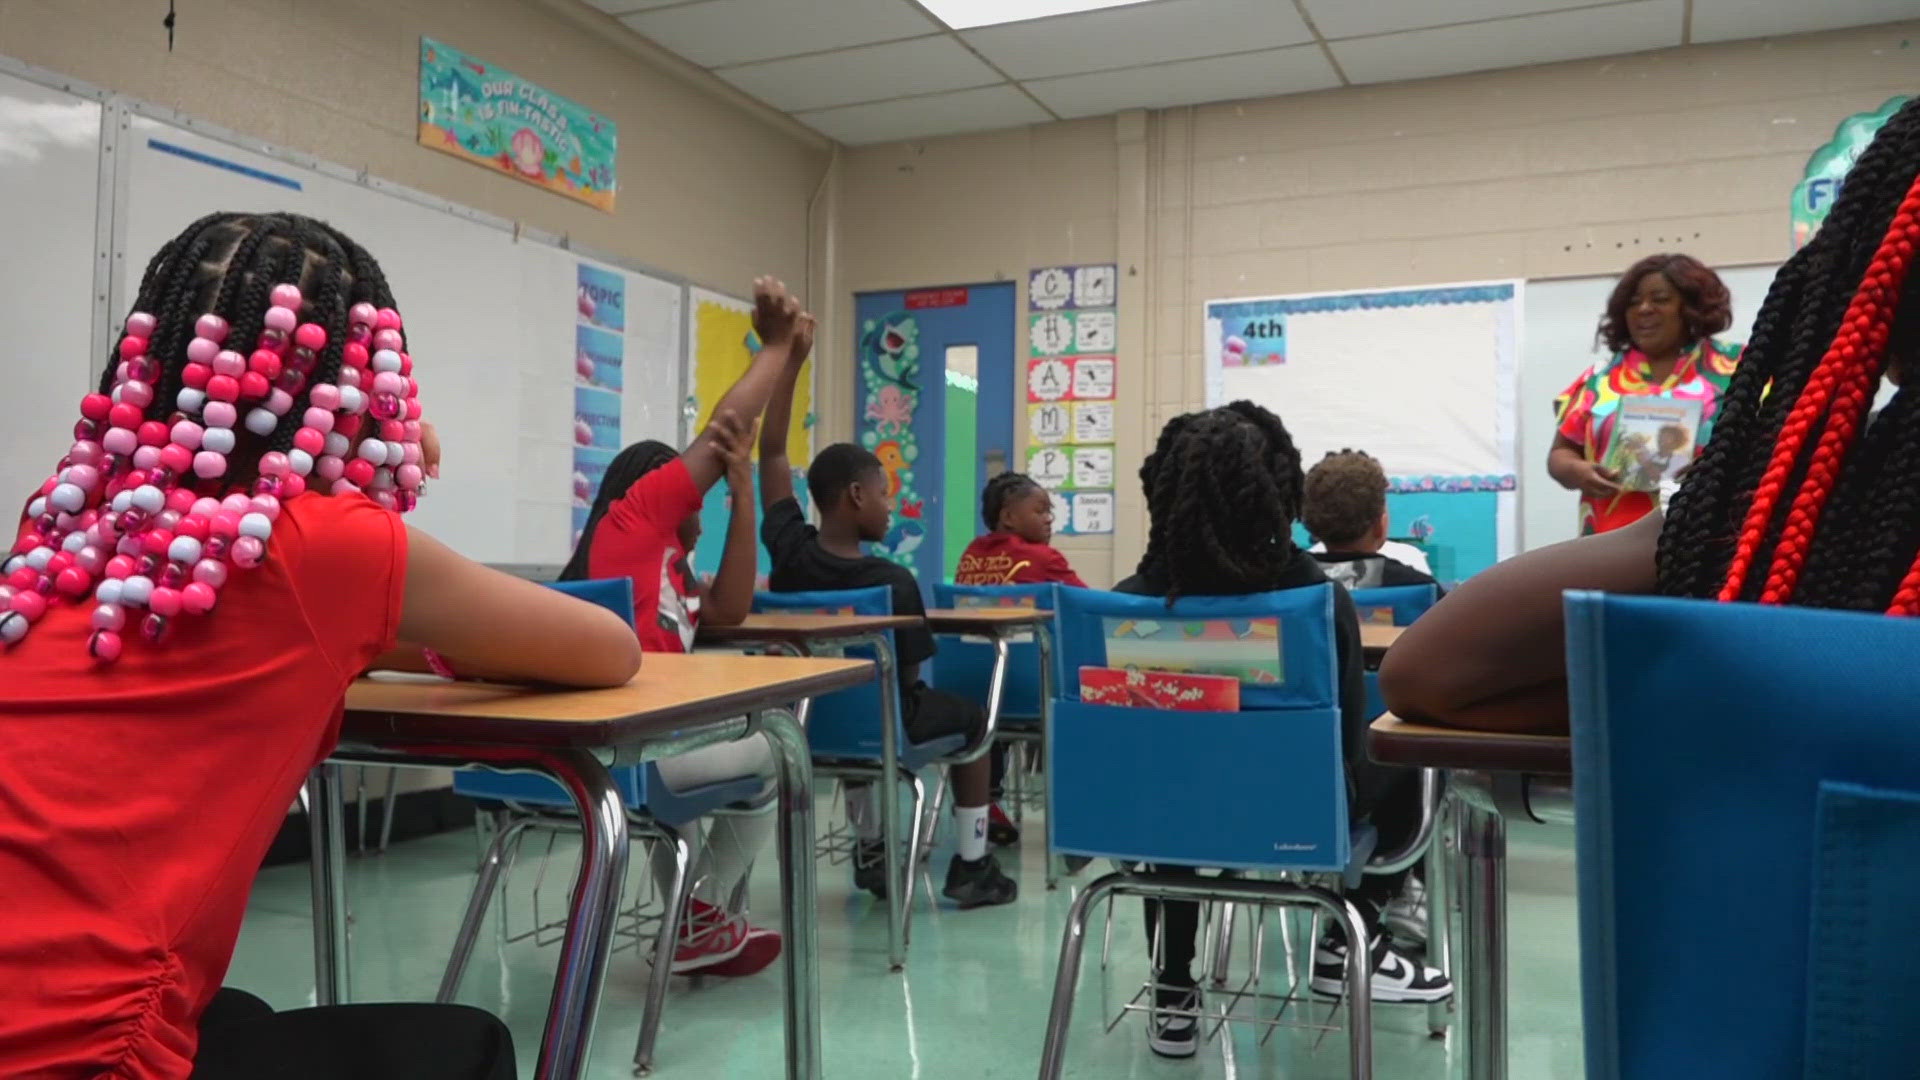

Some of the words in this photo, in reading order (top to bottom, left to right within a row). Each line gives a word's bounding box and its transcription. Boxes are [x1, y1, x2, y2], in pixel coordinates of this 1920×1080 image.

[482, 82, 513, 97] OUR
[519, 84, 568, 131] CLASS
[499, 100, 569, 152] FIN-TASTIC
[580, 282, 621, 309] TOPIC
[1044, 273, 1057, 295] C
[1043, 318, 1061, 341] H
[1242, 319, 1282, 339] 4th
[1041, 364, 1059, 386] A
[1041, 407, 1059, 431] M
[1044, 452, 1055, 474] P
